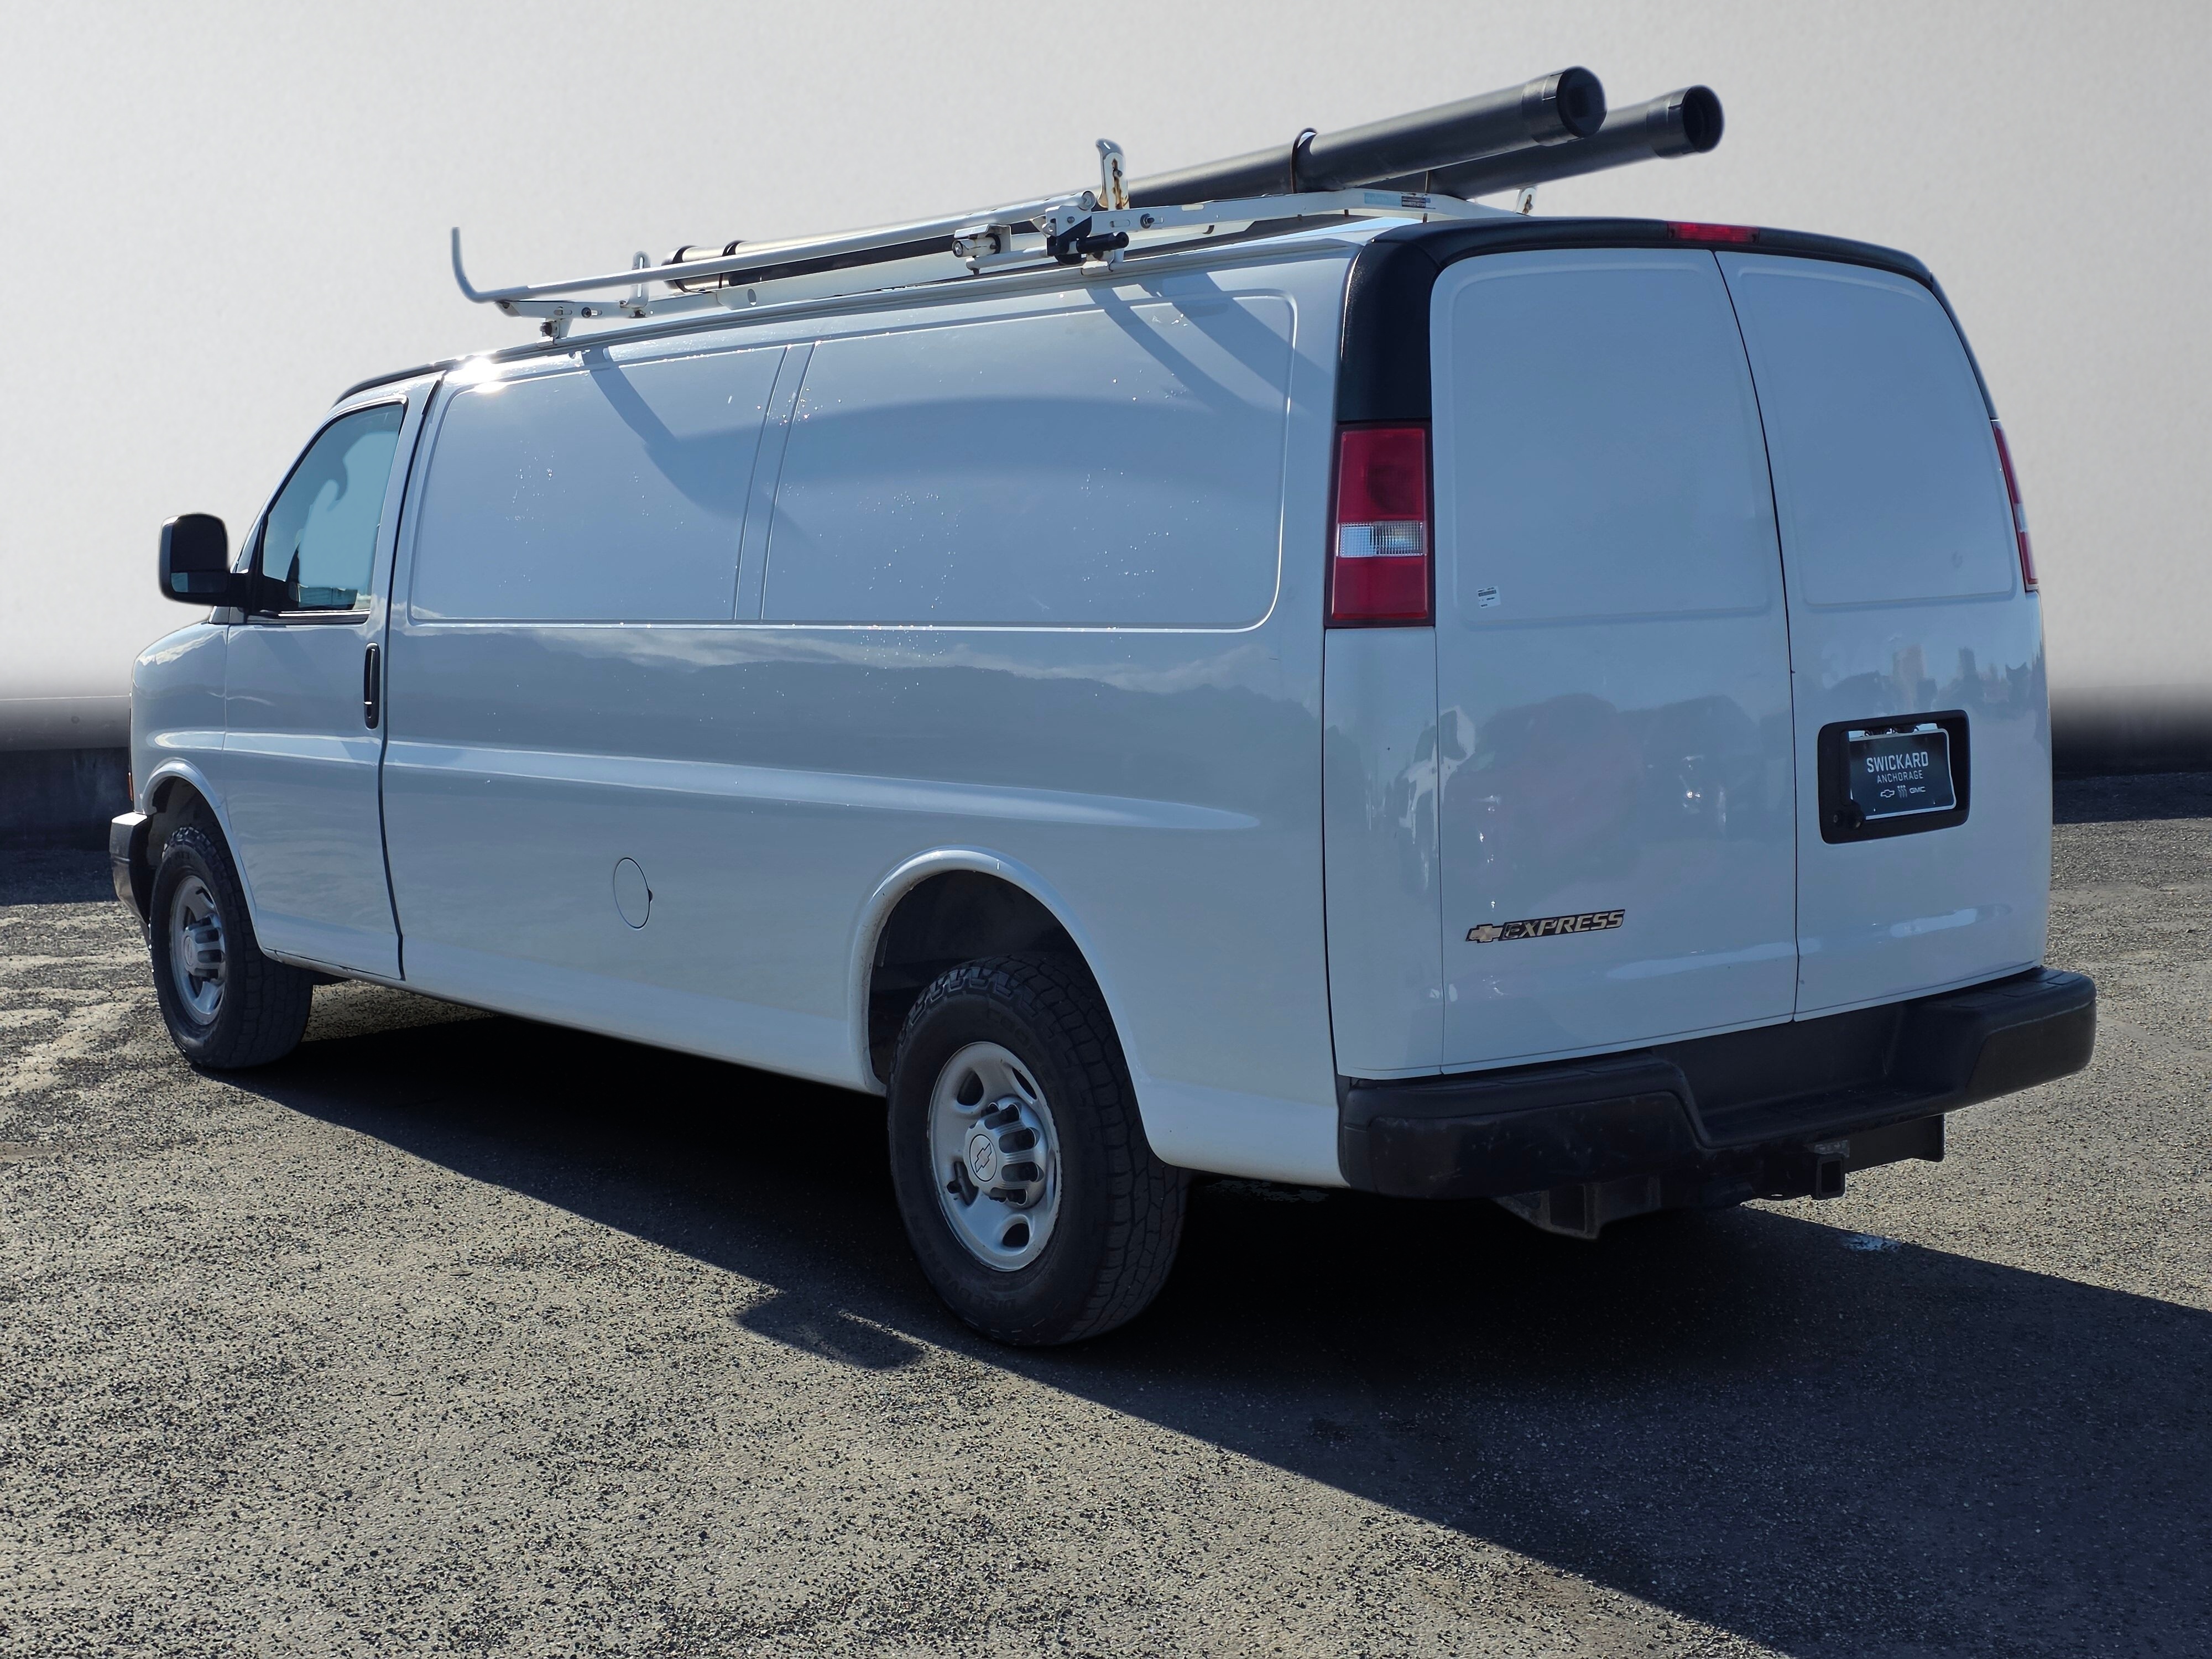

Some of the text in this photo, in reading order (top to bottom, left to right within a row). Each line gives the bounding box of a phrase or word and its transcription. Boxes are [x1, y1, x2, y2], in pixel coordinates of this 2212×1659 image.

[1866, 752, 1928, 773] SWICKARD
[1877, 770, 1923, 784] ANCHORAGE
[1504, 911, 1625, 939] EXPRESS
